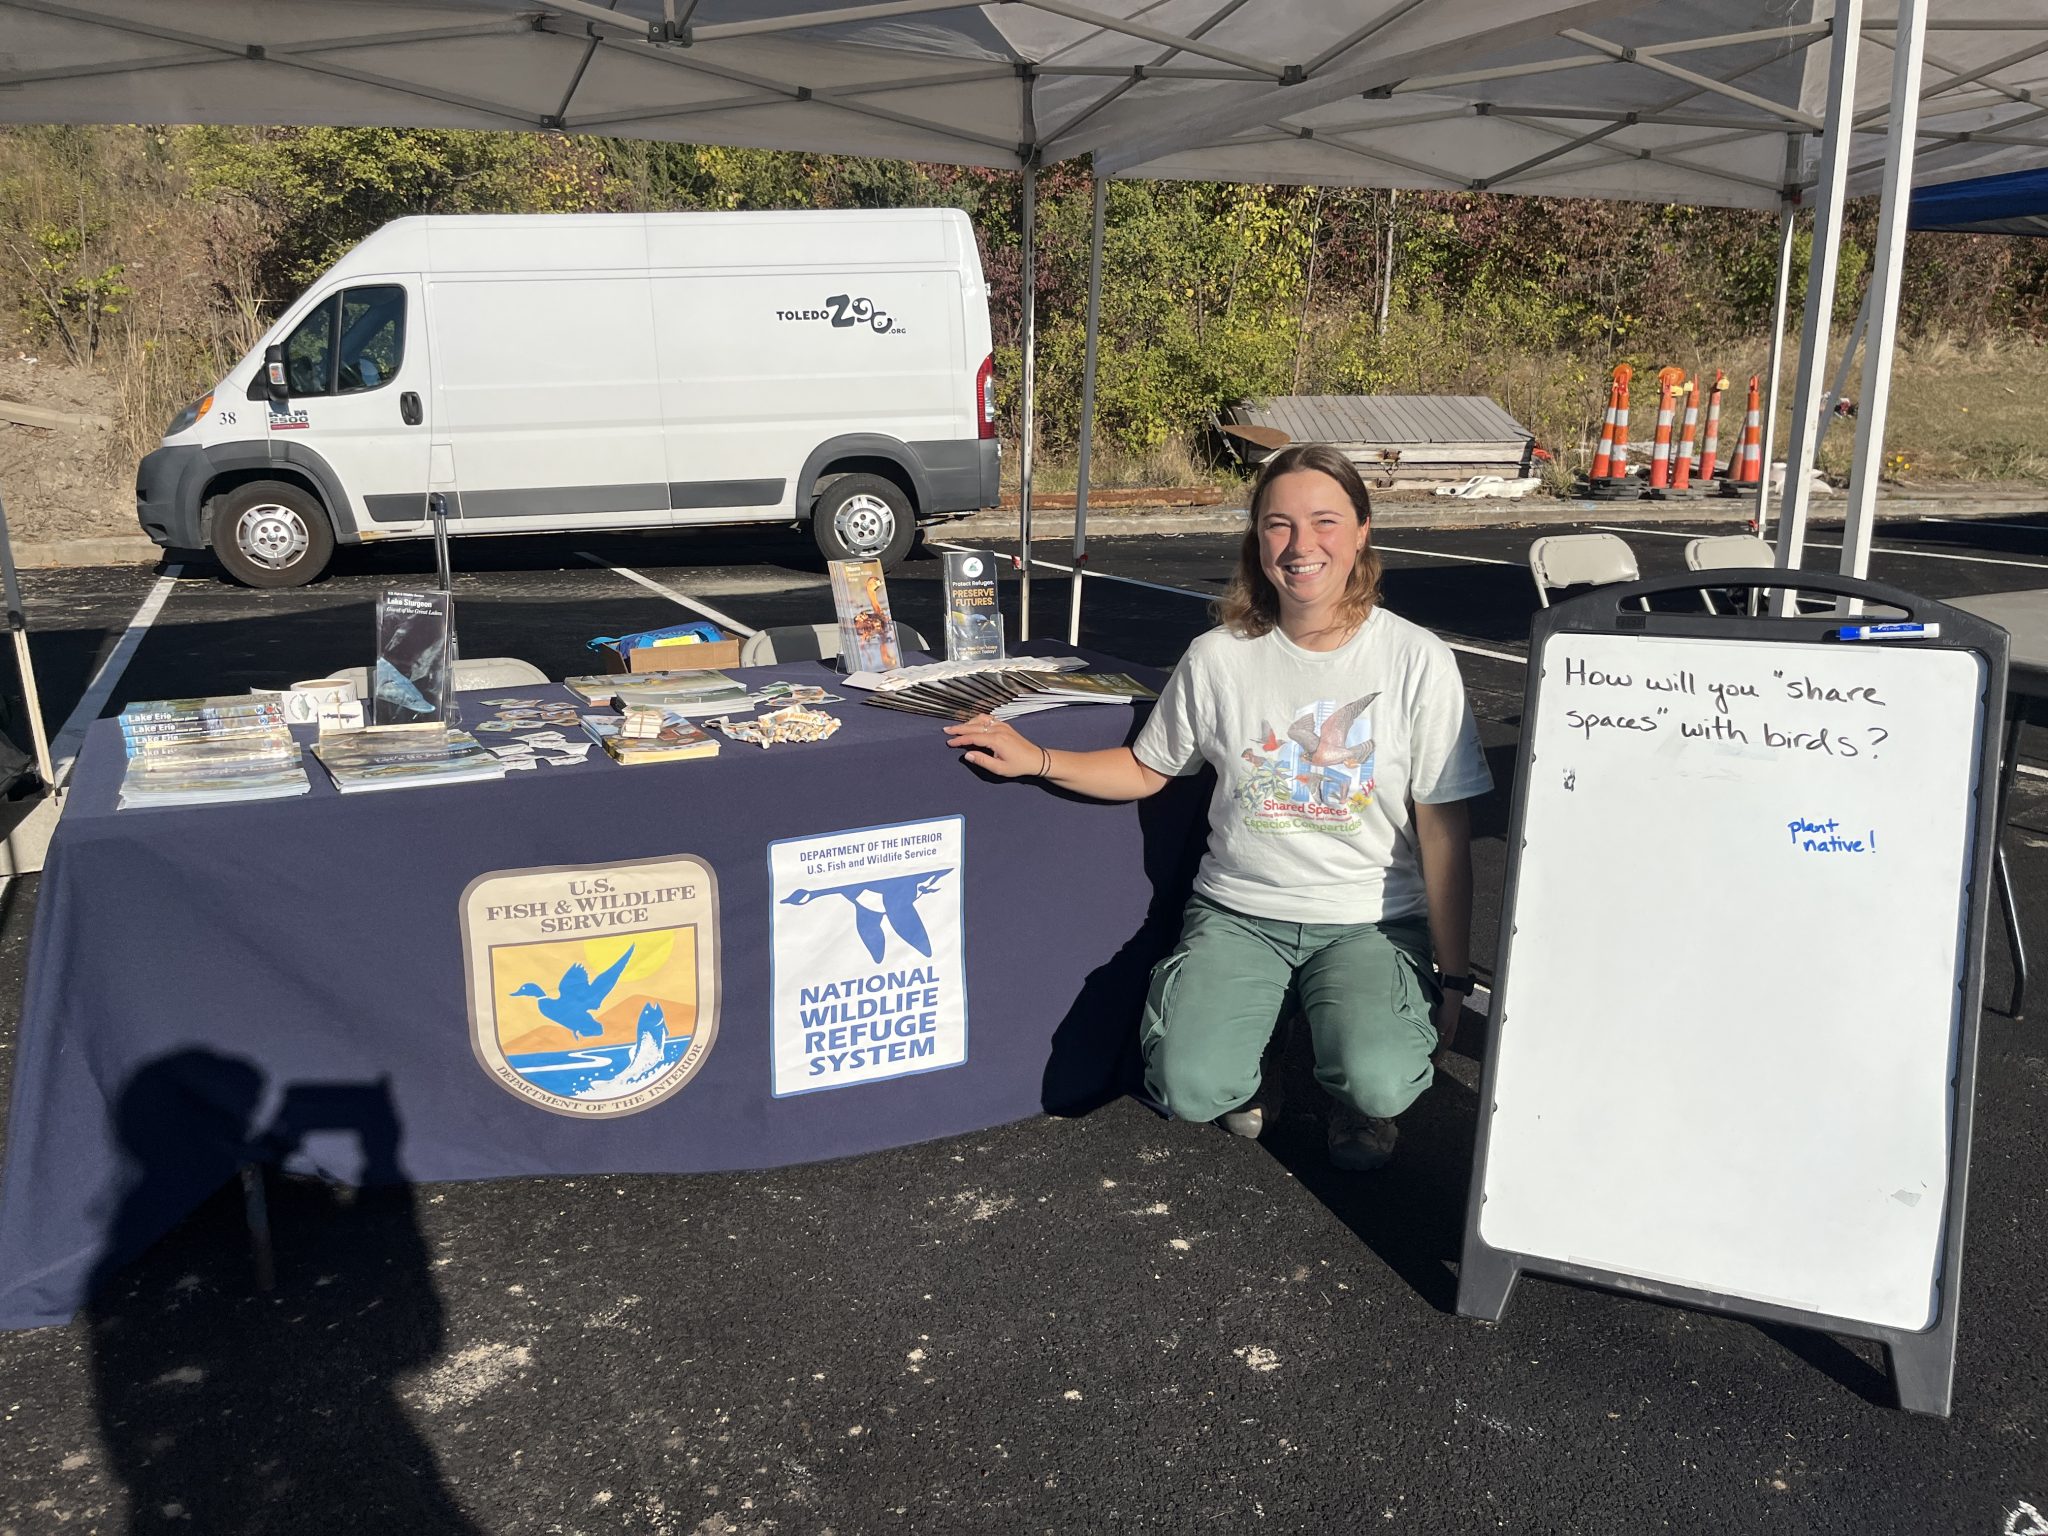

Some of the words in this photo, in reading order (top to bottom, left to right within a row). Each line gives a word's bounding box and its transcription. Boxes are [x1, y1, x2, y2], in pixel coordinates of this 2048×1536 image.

[776, 310, 829, 321] TOLEDO
[219, 412, 236, 425] 38
[270, 416, 309, 424] 2500
[387, 597, 403, 605] Lake
[404, 598, 433, 609] Sturgeon
[952, 588, 995, 598] PRESERVE
[955, 597, 995, 607] FUTURES.
[1565, 656, 1633, 687] How
[1646, 670, 1696, 695] will
[1708, 683, 1760, 714] you
[1773, 669, 1886, 706] "share
[128, 714, 151, 723] Lake
[154, 713, 172, 721] Erie
[132, 725, 155, 734] Lake
[158, 724, 176, 732] Erie
[1565, 706, 1669, 740] spaces"
[1681, 715, 1748, 745] with
[136, 735, 158, 744] Lake
[161, 734, 179, 742] Erie
[1263, 799, 1305, 813] Shared
[1308, 803, 1348, 816] Spaces
[1244, 816, 1291, 830] Espacios
[1292, 818, 1362, 832] Compartidos
[1788, 817, 1839, 844] plant
[800, 843, 865, 862] DEPARTMENT
[867, 841, 879, 852] OF
[881, 838, 898, 850] THE
[900, 832, 942, 847] INTERIOR
[1803, 830, 1876, 854] native!
[807, 863, 826, 875] U.S.
[827, 860, 846, 872] Fish
[848, 857, 865, 868] and
[866, 851, 902, 865] Wildlife
[904, 847, 937, 860] Service
[568, 878, 615, 896] U.S.
[486, 902, 548, 921] FISH
[554, 900, 572, 915] &
[574, 885, 696, 913] WILDLIFE
[541, 907, 649, 933] SERVICE
[800, 965, 940, 1006] NATIONAL
[800, 986, 939, 1029] WILDLIFE
[805, 1010, 937, 1054] REFUGE
[809, 1035, 935, 1076] SYSTEM
[497, 1066, 582, 1111] DEPARTMENT
[586, 1103, 606, 1112] OF
[611, 1094, 645, 1110] THE
[649, 1043, 704, 1097] INTERIOR
